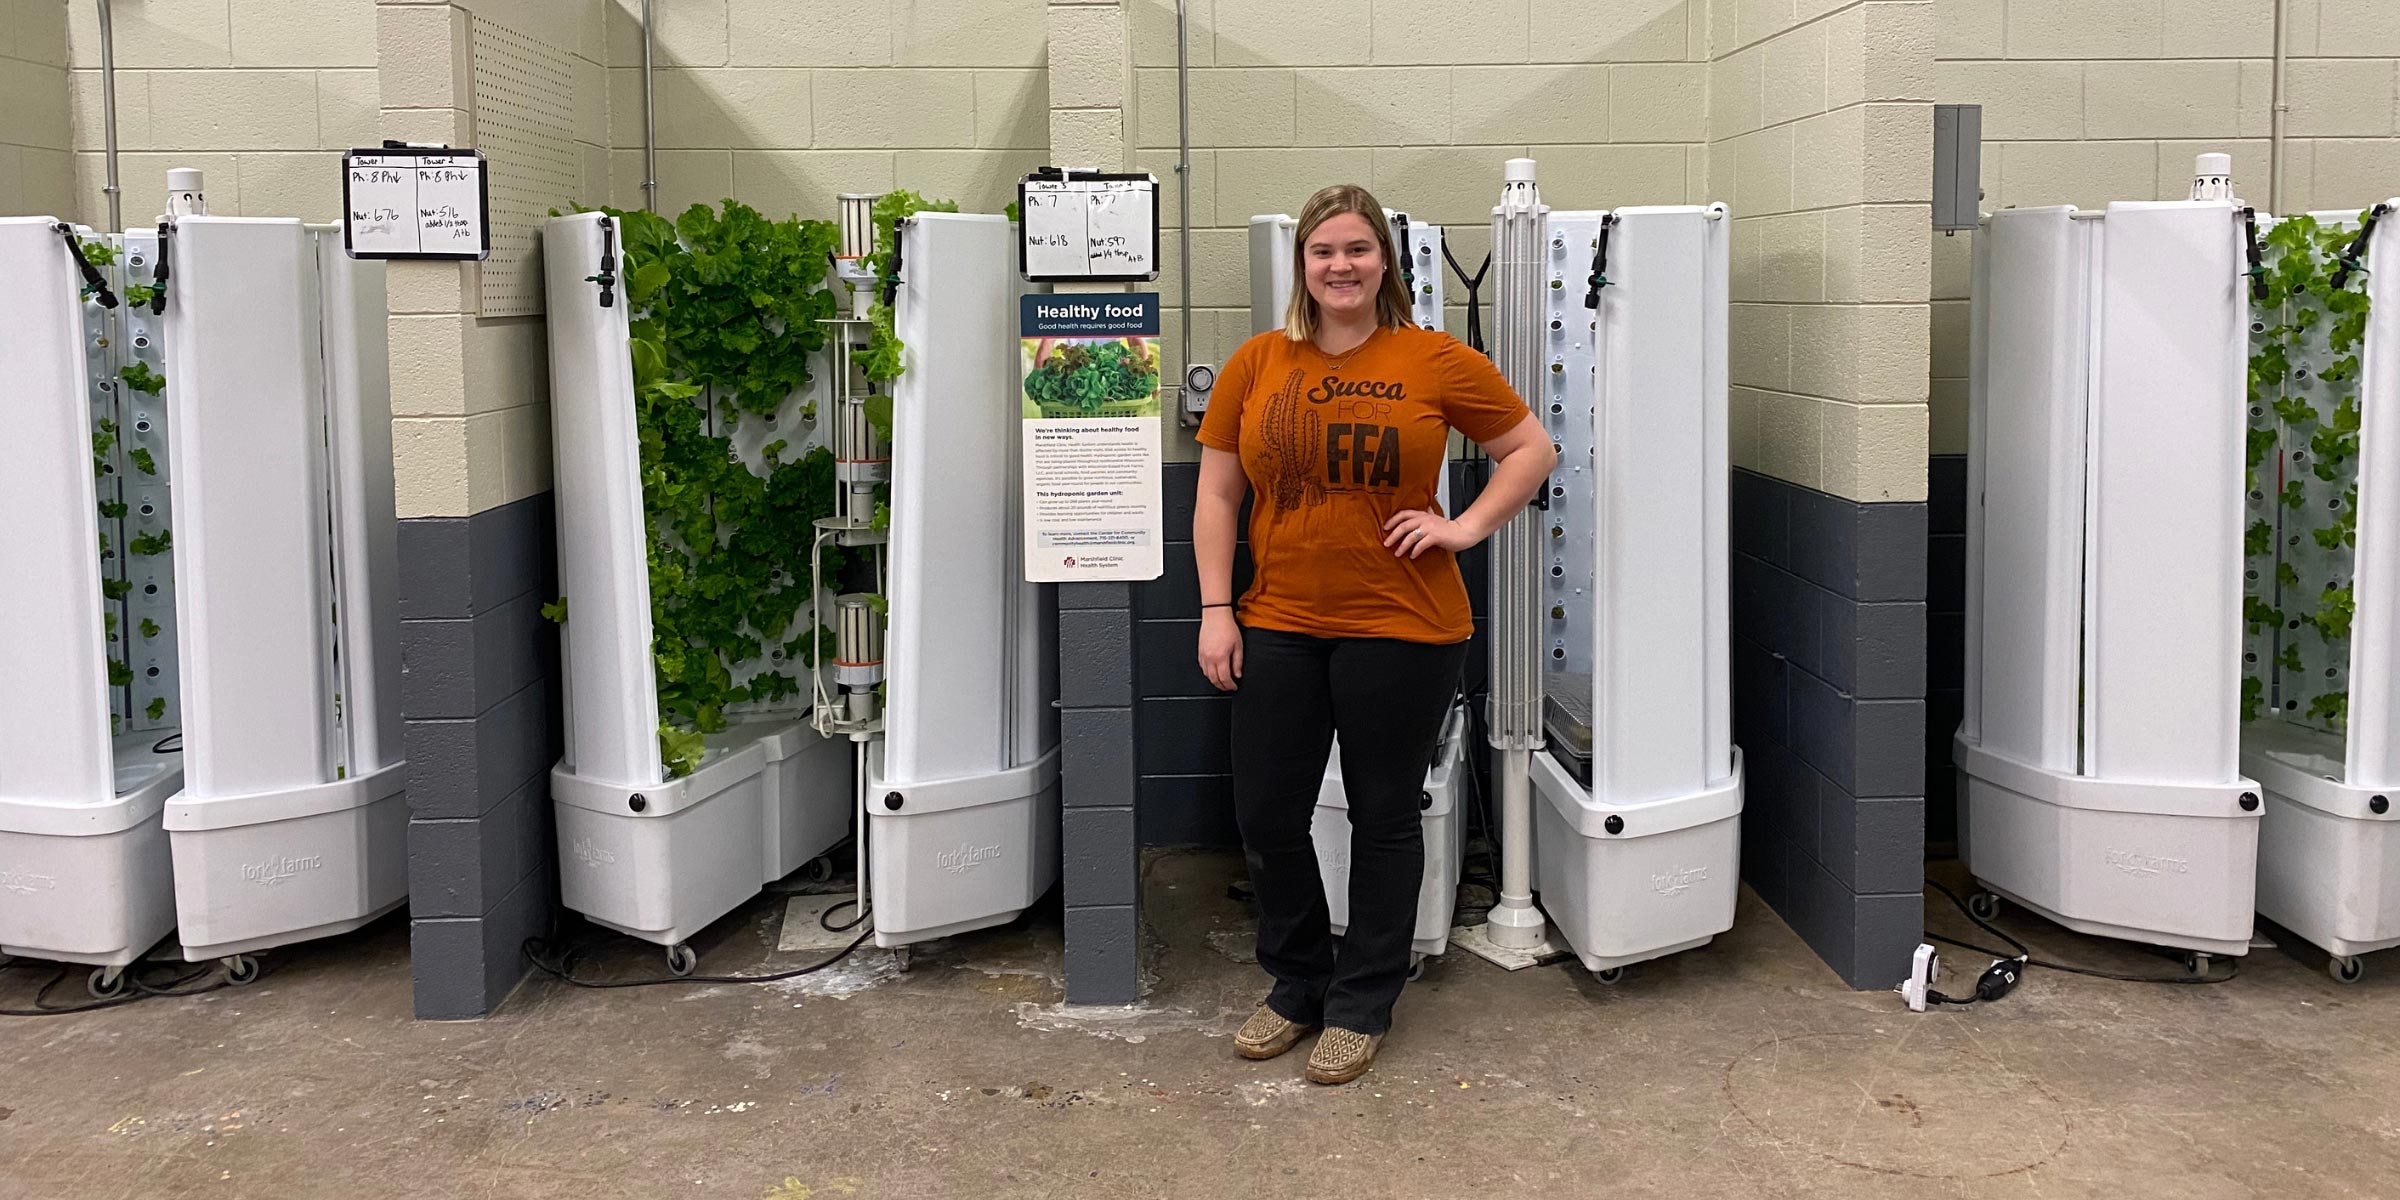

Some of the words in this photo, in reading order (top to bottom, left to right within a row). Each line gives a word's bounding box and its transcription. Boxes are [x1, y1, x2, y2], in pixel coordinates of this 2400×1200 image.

[355, 156, 378, 165] Tower
[422, 156, 446, 165] Tower
[1037, 305, 1100, 320] Healthy
[1104, 304, 1143, 317] food
[1307, 376, 1407, 404] Succa
[1338, 401, 1391, 421] FOR
[1327, 423, 1399, 487] FFA
[970, 844, 1000, 862] farms
[241, 861, 270, 880] fork
[280, 855, 320, 873] farms
